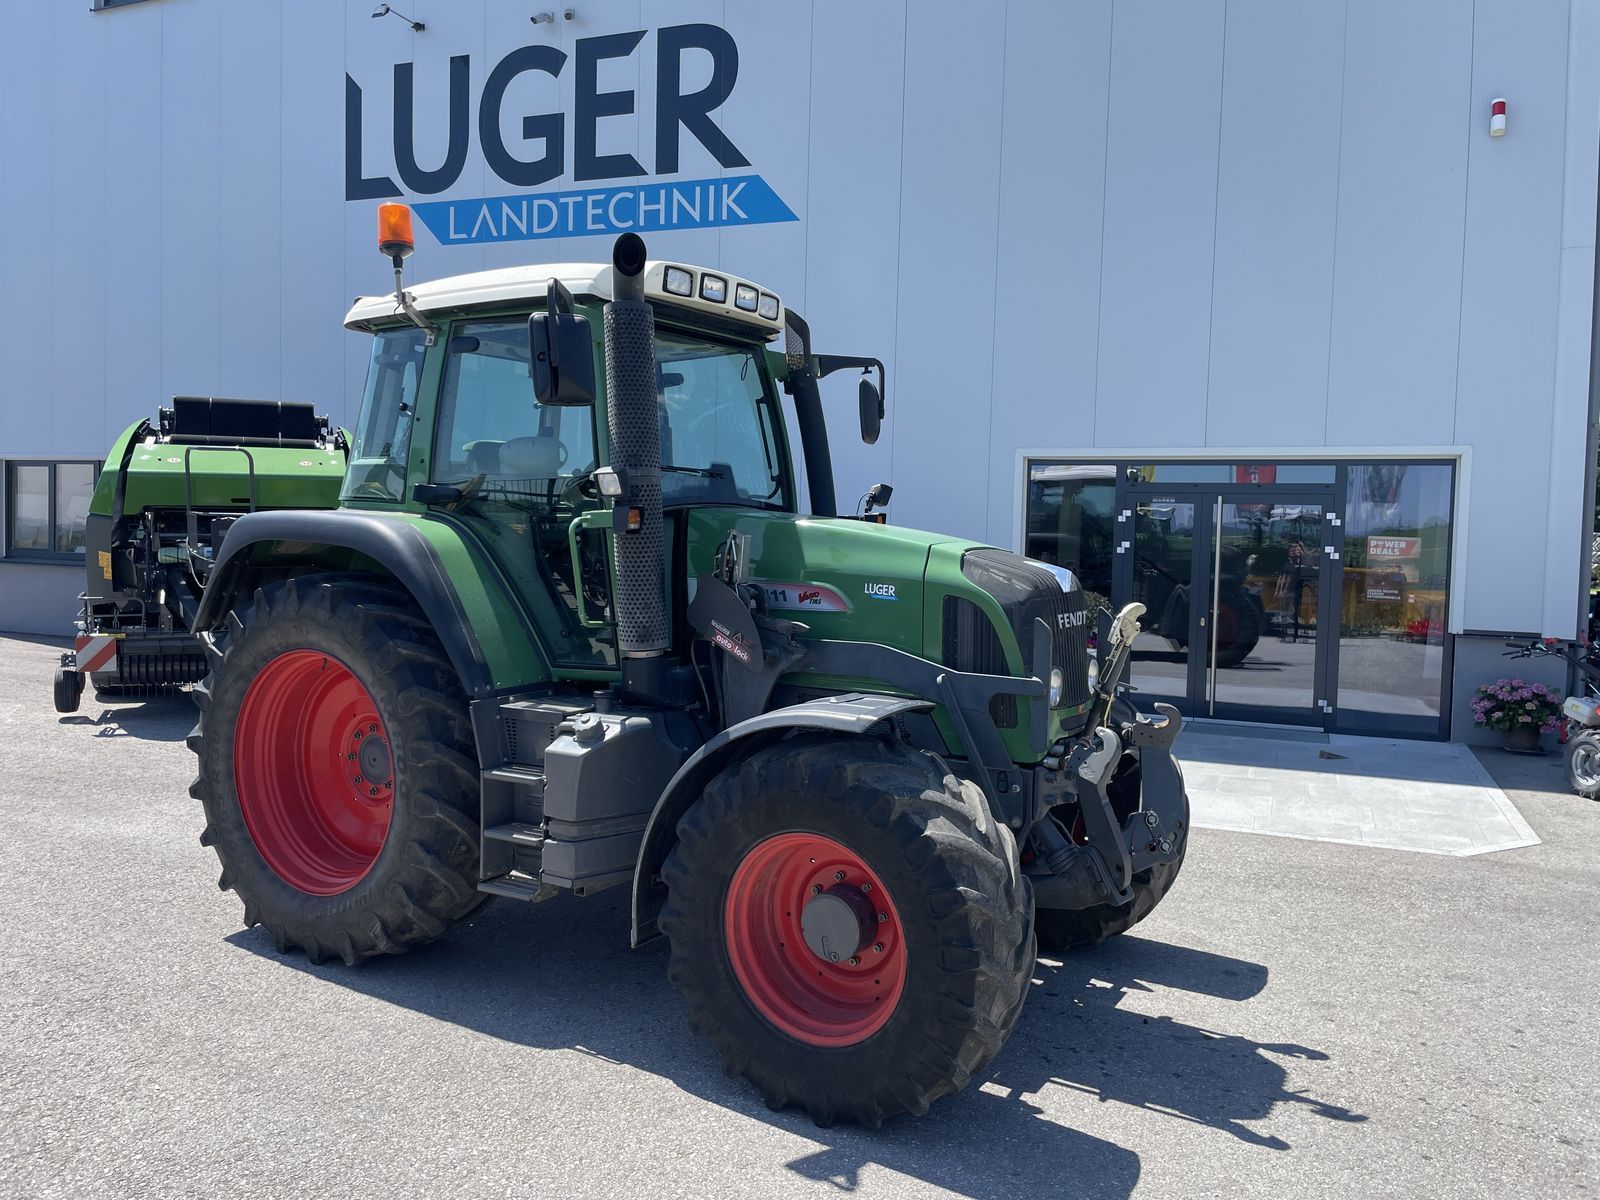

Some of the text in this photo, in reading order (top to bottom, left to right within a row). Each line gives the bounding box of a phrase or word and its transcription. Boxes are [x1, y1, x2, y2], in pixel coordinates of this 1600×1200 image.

[345, 23, 752, 201] LUGER
[449, 182, 749, 240] LANDTECHNIK
[1370, 540, 1406, 548] PWER
[864, 583, 896, 597] LUGER
[1058, 610, 1088, 629] FENDT
[716, 634, 732, 649] auto
[733, 646, 749, 661] lock
